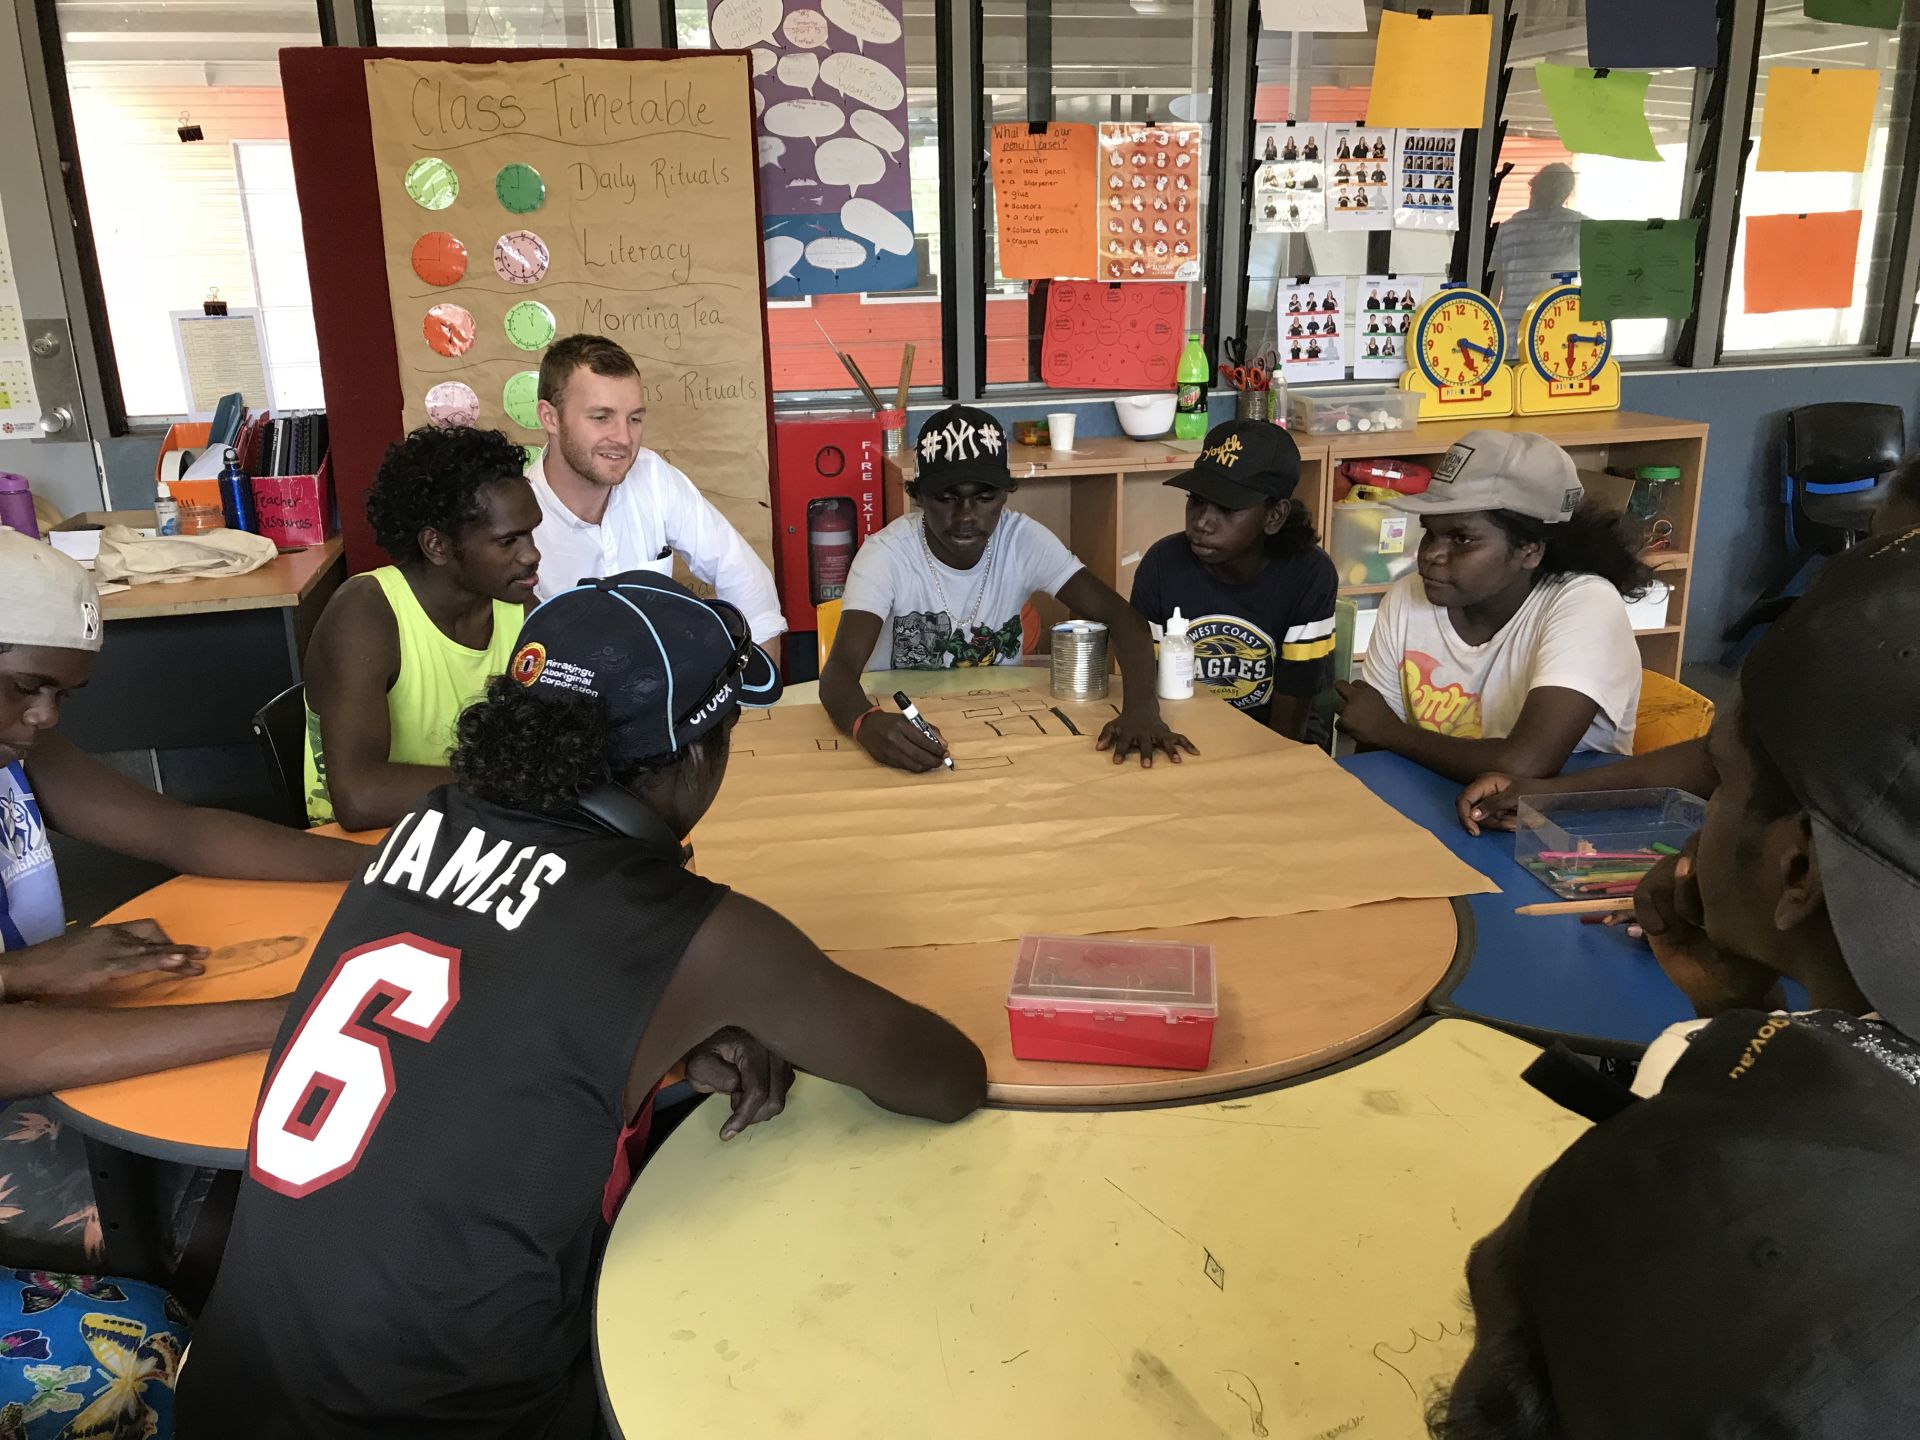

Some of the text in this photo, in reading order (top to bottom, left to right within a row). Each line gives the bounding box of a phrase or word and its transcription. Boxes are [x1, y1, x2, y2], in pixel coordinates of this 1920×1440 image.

[411, 73, 714, 137] Class Timetable
[994, 126, 1019, 138] What
[567, 156, 730, 204] Daily Rituals
[582, 228, 692, 285] Literacy
[1456, 304, 1466, 315] 12
[1566, 300, 1576, 311] 12
[1442, 310, 1451, 321] 11
[1553, 306, 1561, 317] 11
[579, 297, 724, 350] Morning Tea
[1432, 323, 1444, 334] 10
[1483, 319, 1489, 331] 2
[1543, 318, 1554, 329] 10
[1427, 339, 1434, 351] 9
[1487, 336, 1494, 347] 3
[1538, 335, 1545, 346] 9
[1543, 351, 1550, 362] 8
[1591, 348, 1598, 359] 4
[1432, 356, 1439, 367] 8
[1581, 361, 1588, 372] 5
[1443, 368, 1449, 378] 7
[1472, 366, 1479, 377] 5
[1553, 362, 1560, 373] 7
[1567, 366, 1574, 377] 6
[1457, 371, 1465, 382] 6
[678, 371, 757, 410] Rituals
[1215, 453, 1239, 467] NT
[861, 441, 874, 539] FIRE EXTI
[253, 490, 302, 508] Teacher
[1188, 624, 1262, 648] WEST COAST
[1194, 657, 1266, 680] AGLES
[542, 668, 592, 686] Aboriginal
[1234, 689, 1265, 707] WEAR
[363, 808, 567, 931] JAMES
[248, 931, 462, 1200] 6
